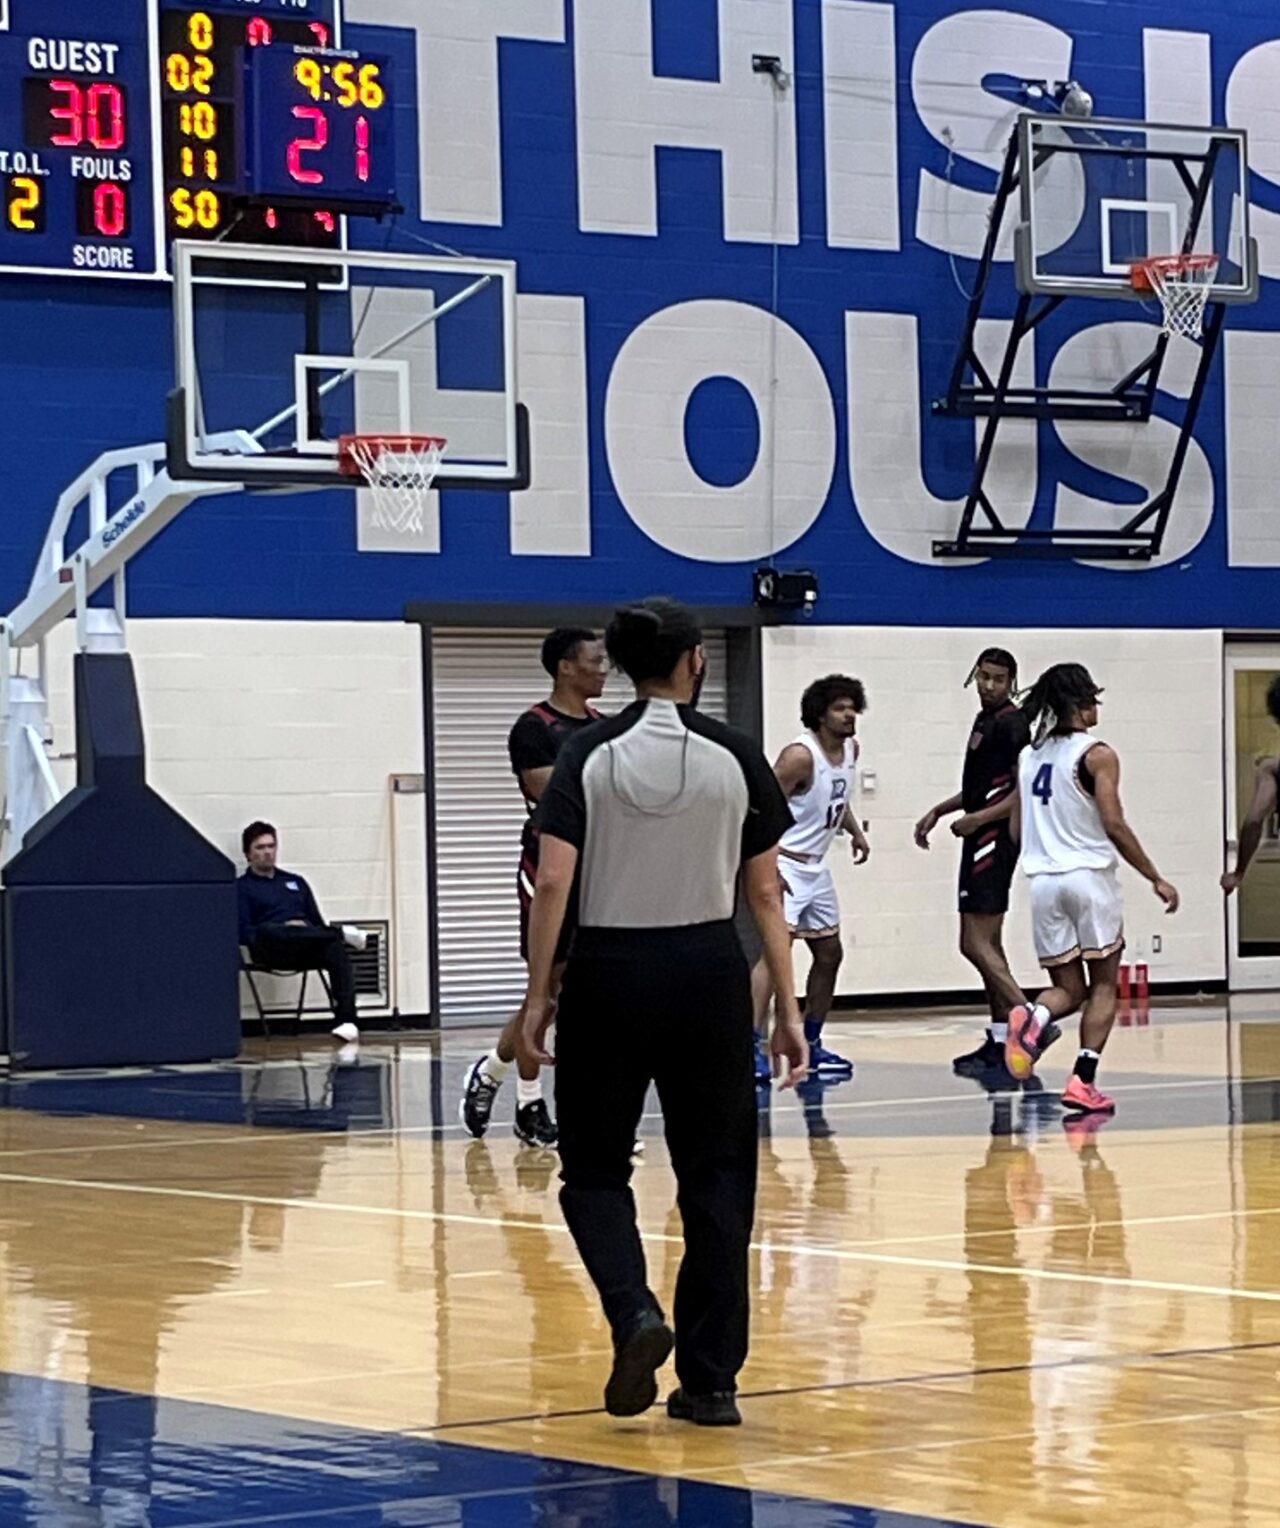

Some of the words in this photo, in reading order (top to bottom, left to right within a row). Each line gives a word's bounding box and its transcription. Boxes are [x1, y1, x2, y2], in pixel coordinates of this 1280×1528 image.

[28, 37, 119, 75] GUEST
[166, 53, 213, 94] 02
[295, 58, 384, 108] 9:56
[49, 80, 124, 149] 30
[180, 102, 215, 139] 10
[343, 0, 1086, 261] THIS
[182, 146, 217, 180] 11
[287, 105, 369, 183] 21
[71, 156, 131, 181] FOULS
[9, 177, 39, 229] 2
[94, 183, 125, 235] 0
[170, 187, 218, 228] 50
[72, 244, 134, 269] SCORE
[1032, 763, 1053, 805] 4
